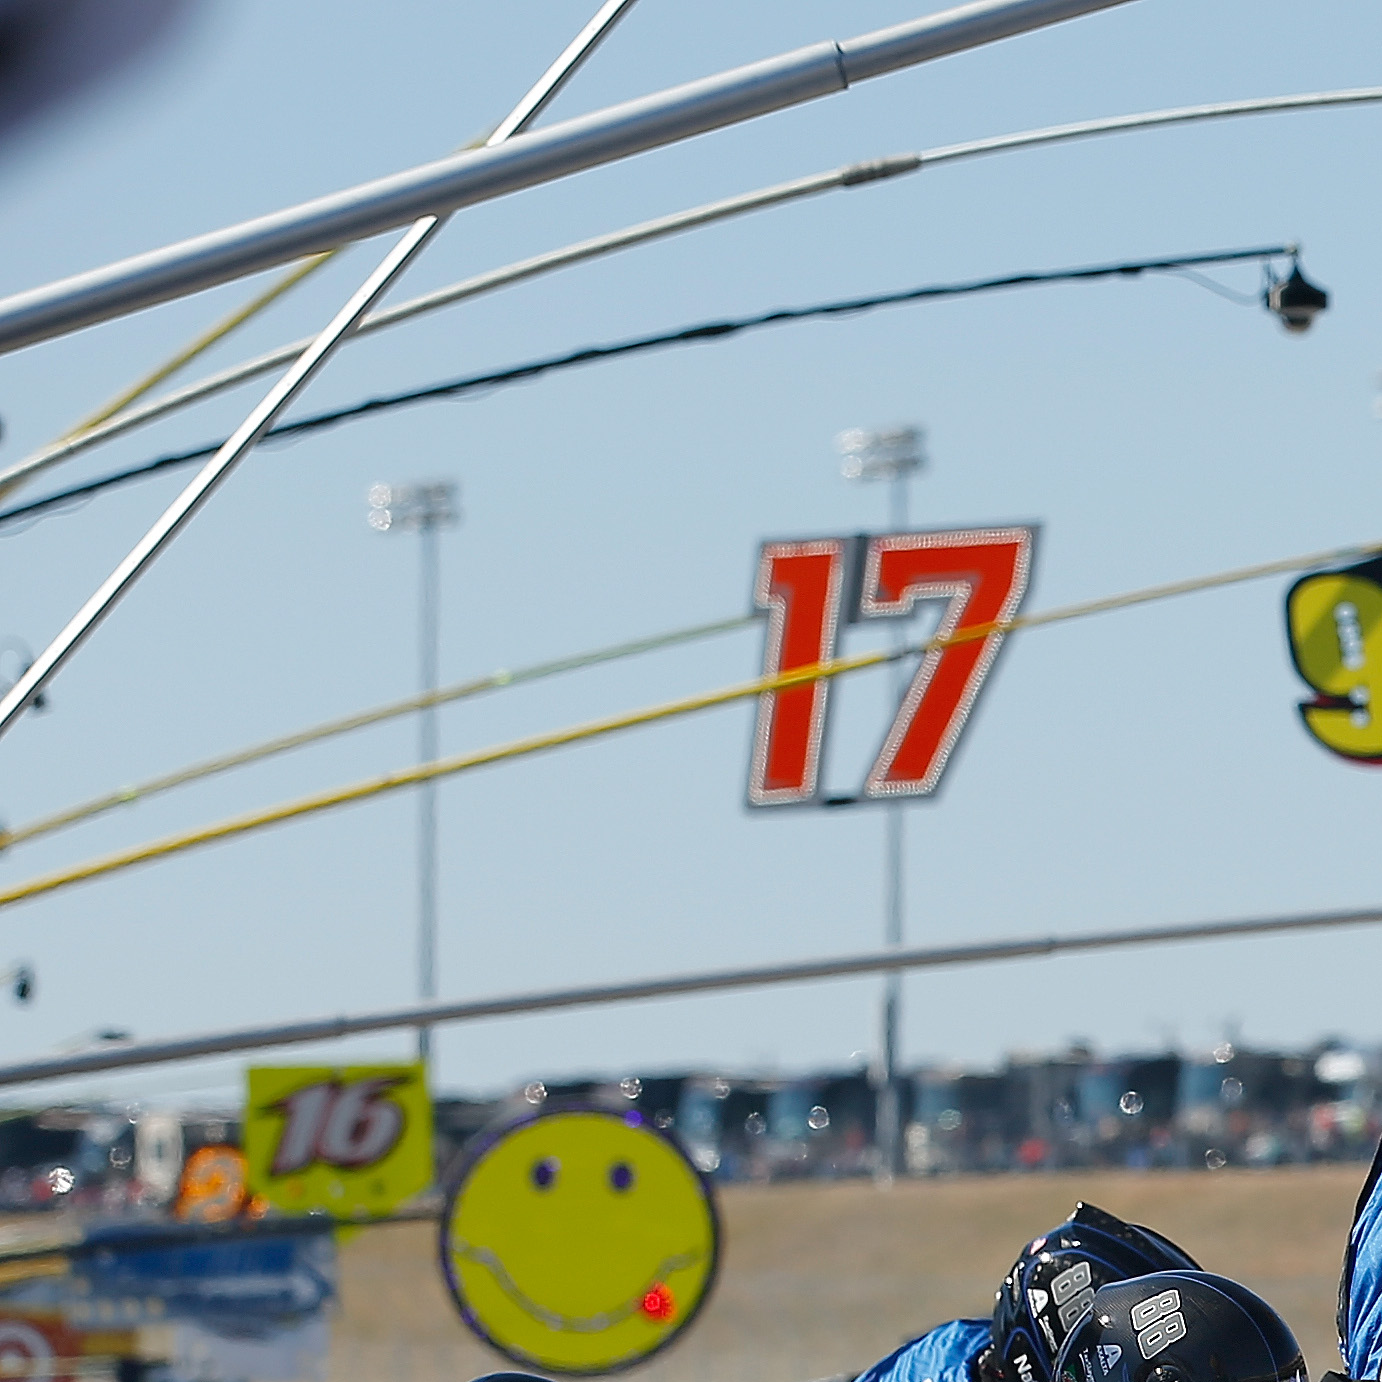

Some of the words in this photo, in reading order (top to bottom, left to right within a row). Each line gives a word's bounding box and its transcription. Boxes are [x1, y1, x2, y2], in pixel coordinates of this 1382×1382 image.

[746, 526, 1034, 804] 17
[268, 1075, 412, 1178] 16
[1130, 1288, 1188, 1361] 88
